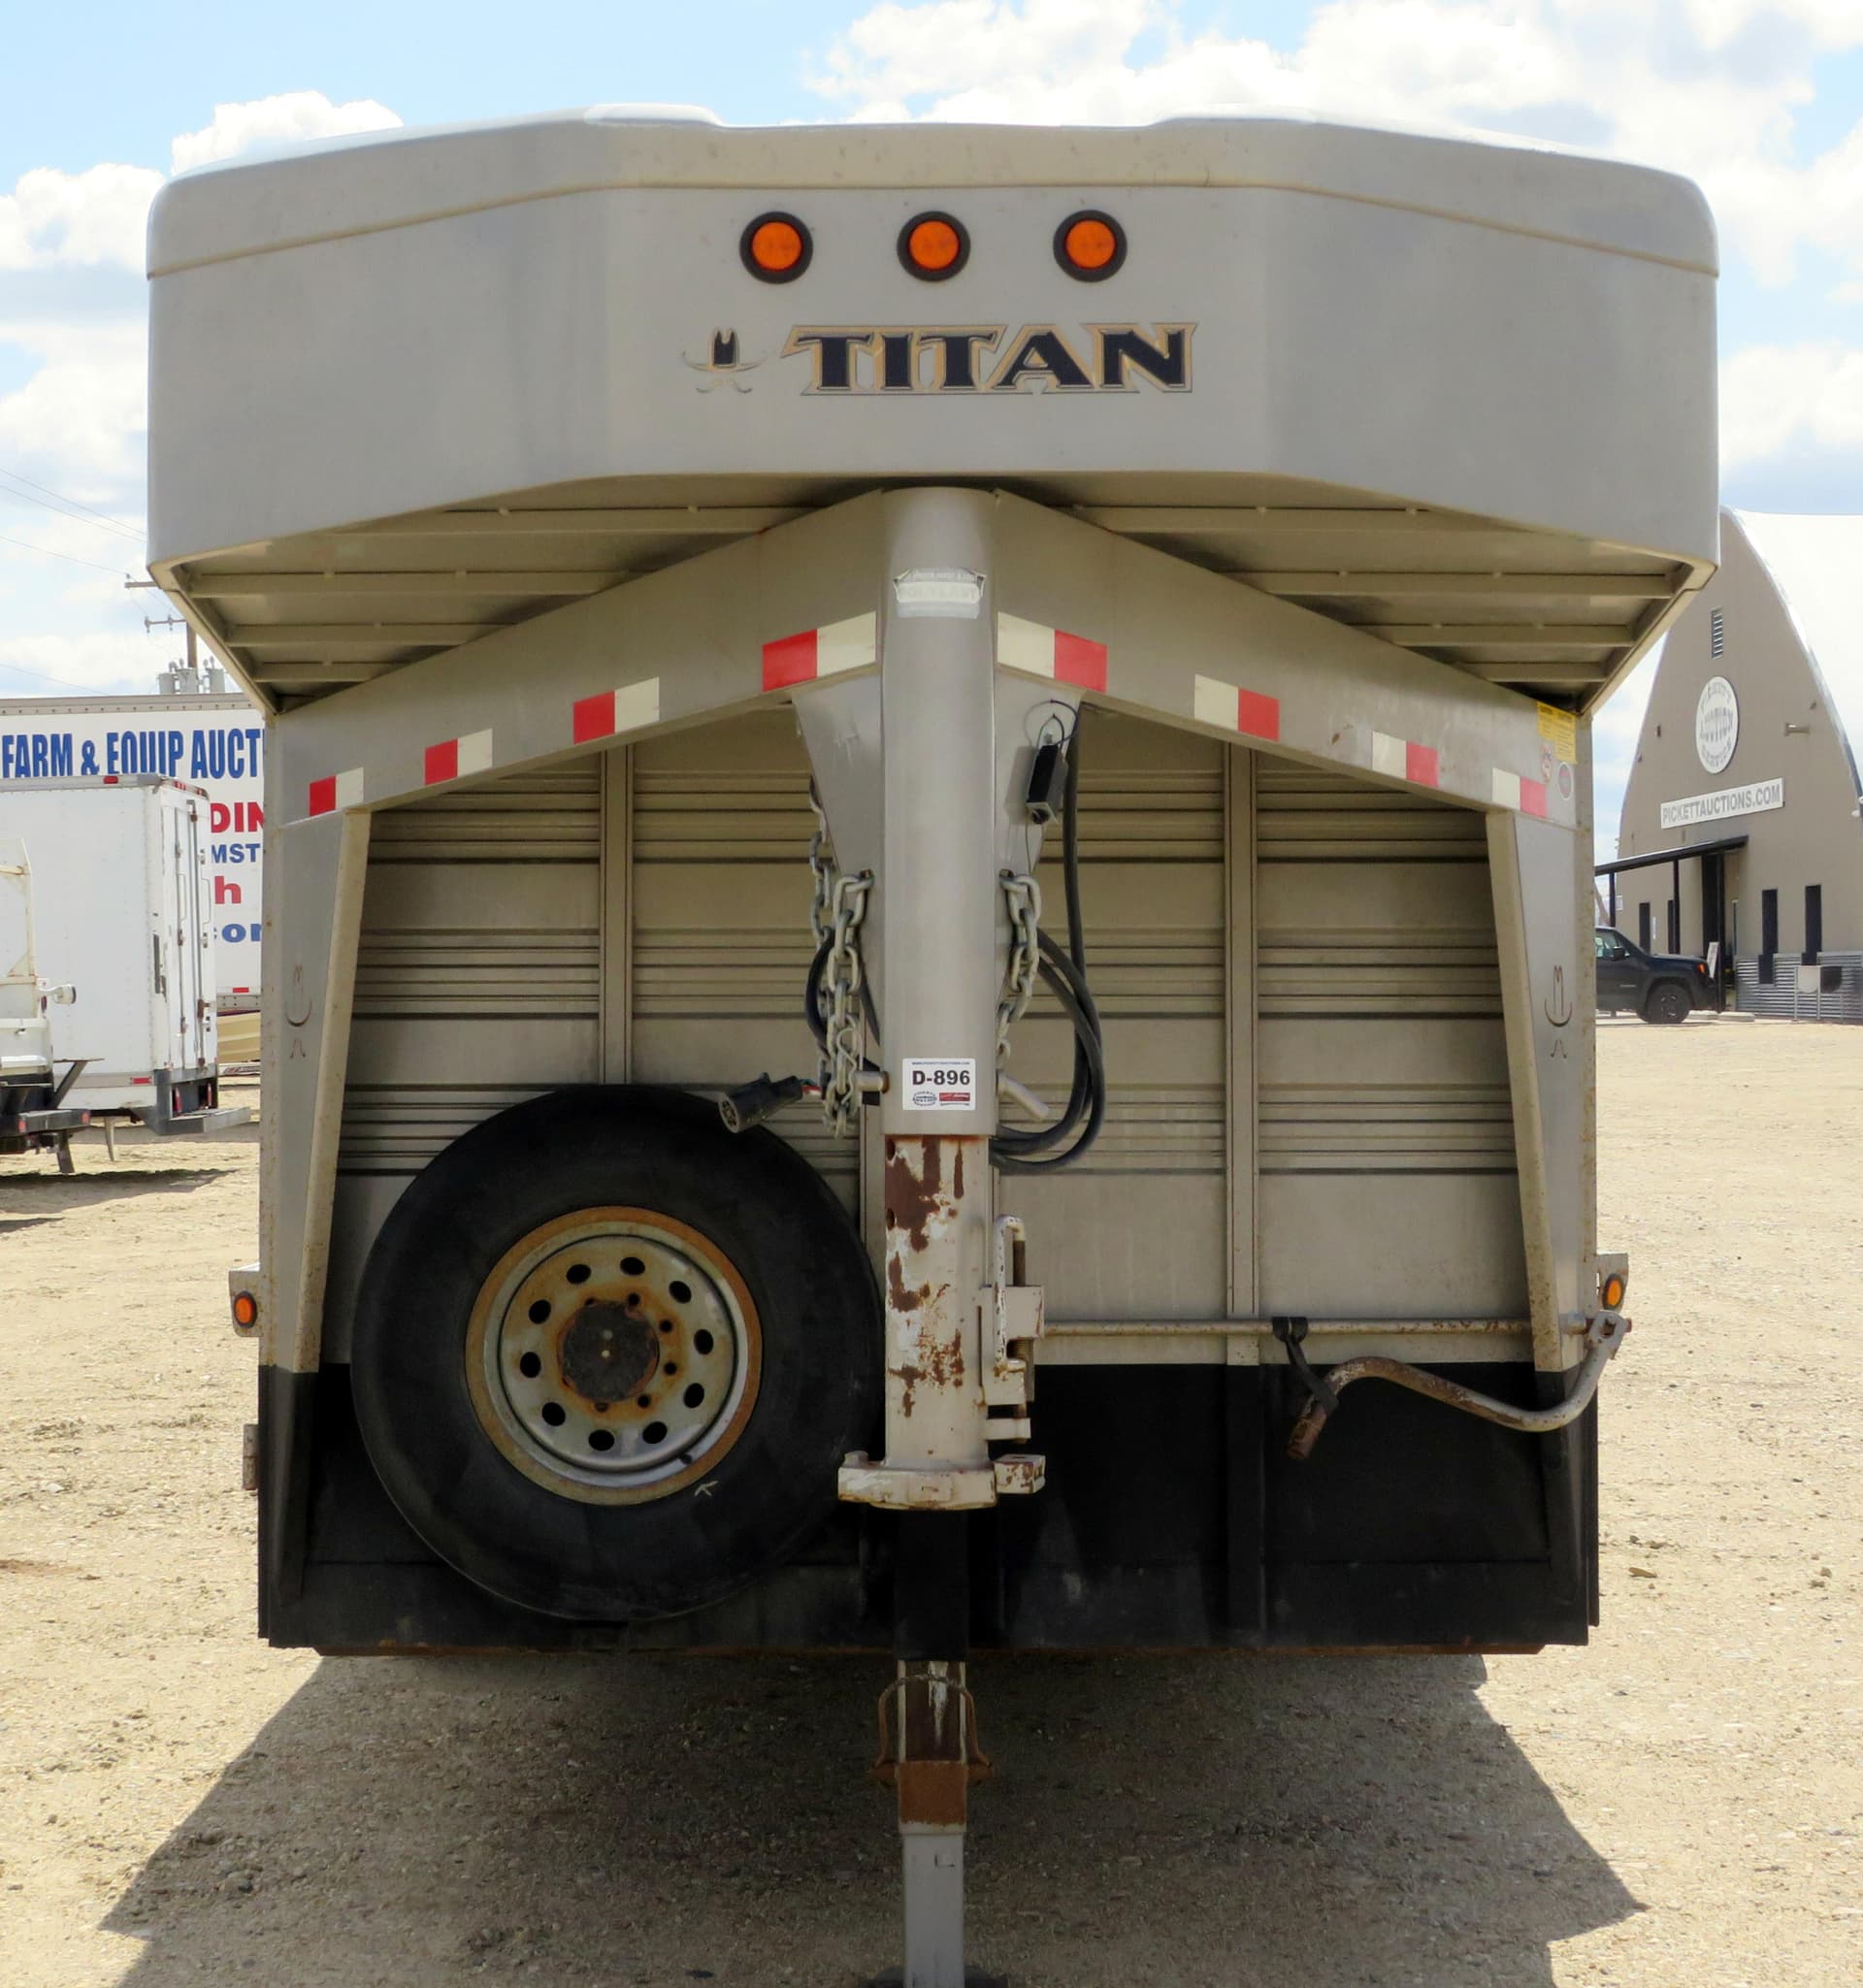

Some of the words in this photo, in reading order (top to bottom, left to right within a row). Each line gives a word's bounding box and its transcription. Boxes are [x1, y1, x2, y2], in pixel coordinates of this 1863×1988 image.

[780, 322, 1198, 396] TITAN
[2, 733, 73, 778] FARM
[81, 740, 100, 776] &
[107, 731, 183, 777] EQUIP
[191, 728, 264, 779] AUCT
[1662, 784, 1781, 824] PICKETTAUCTIONS.COM
[912, 1070, 970, 1086] D-896
